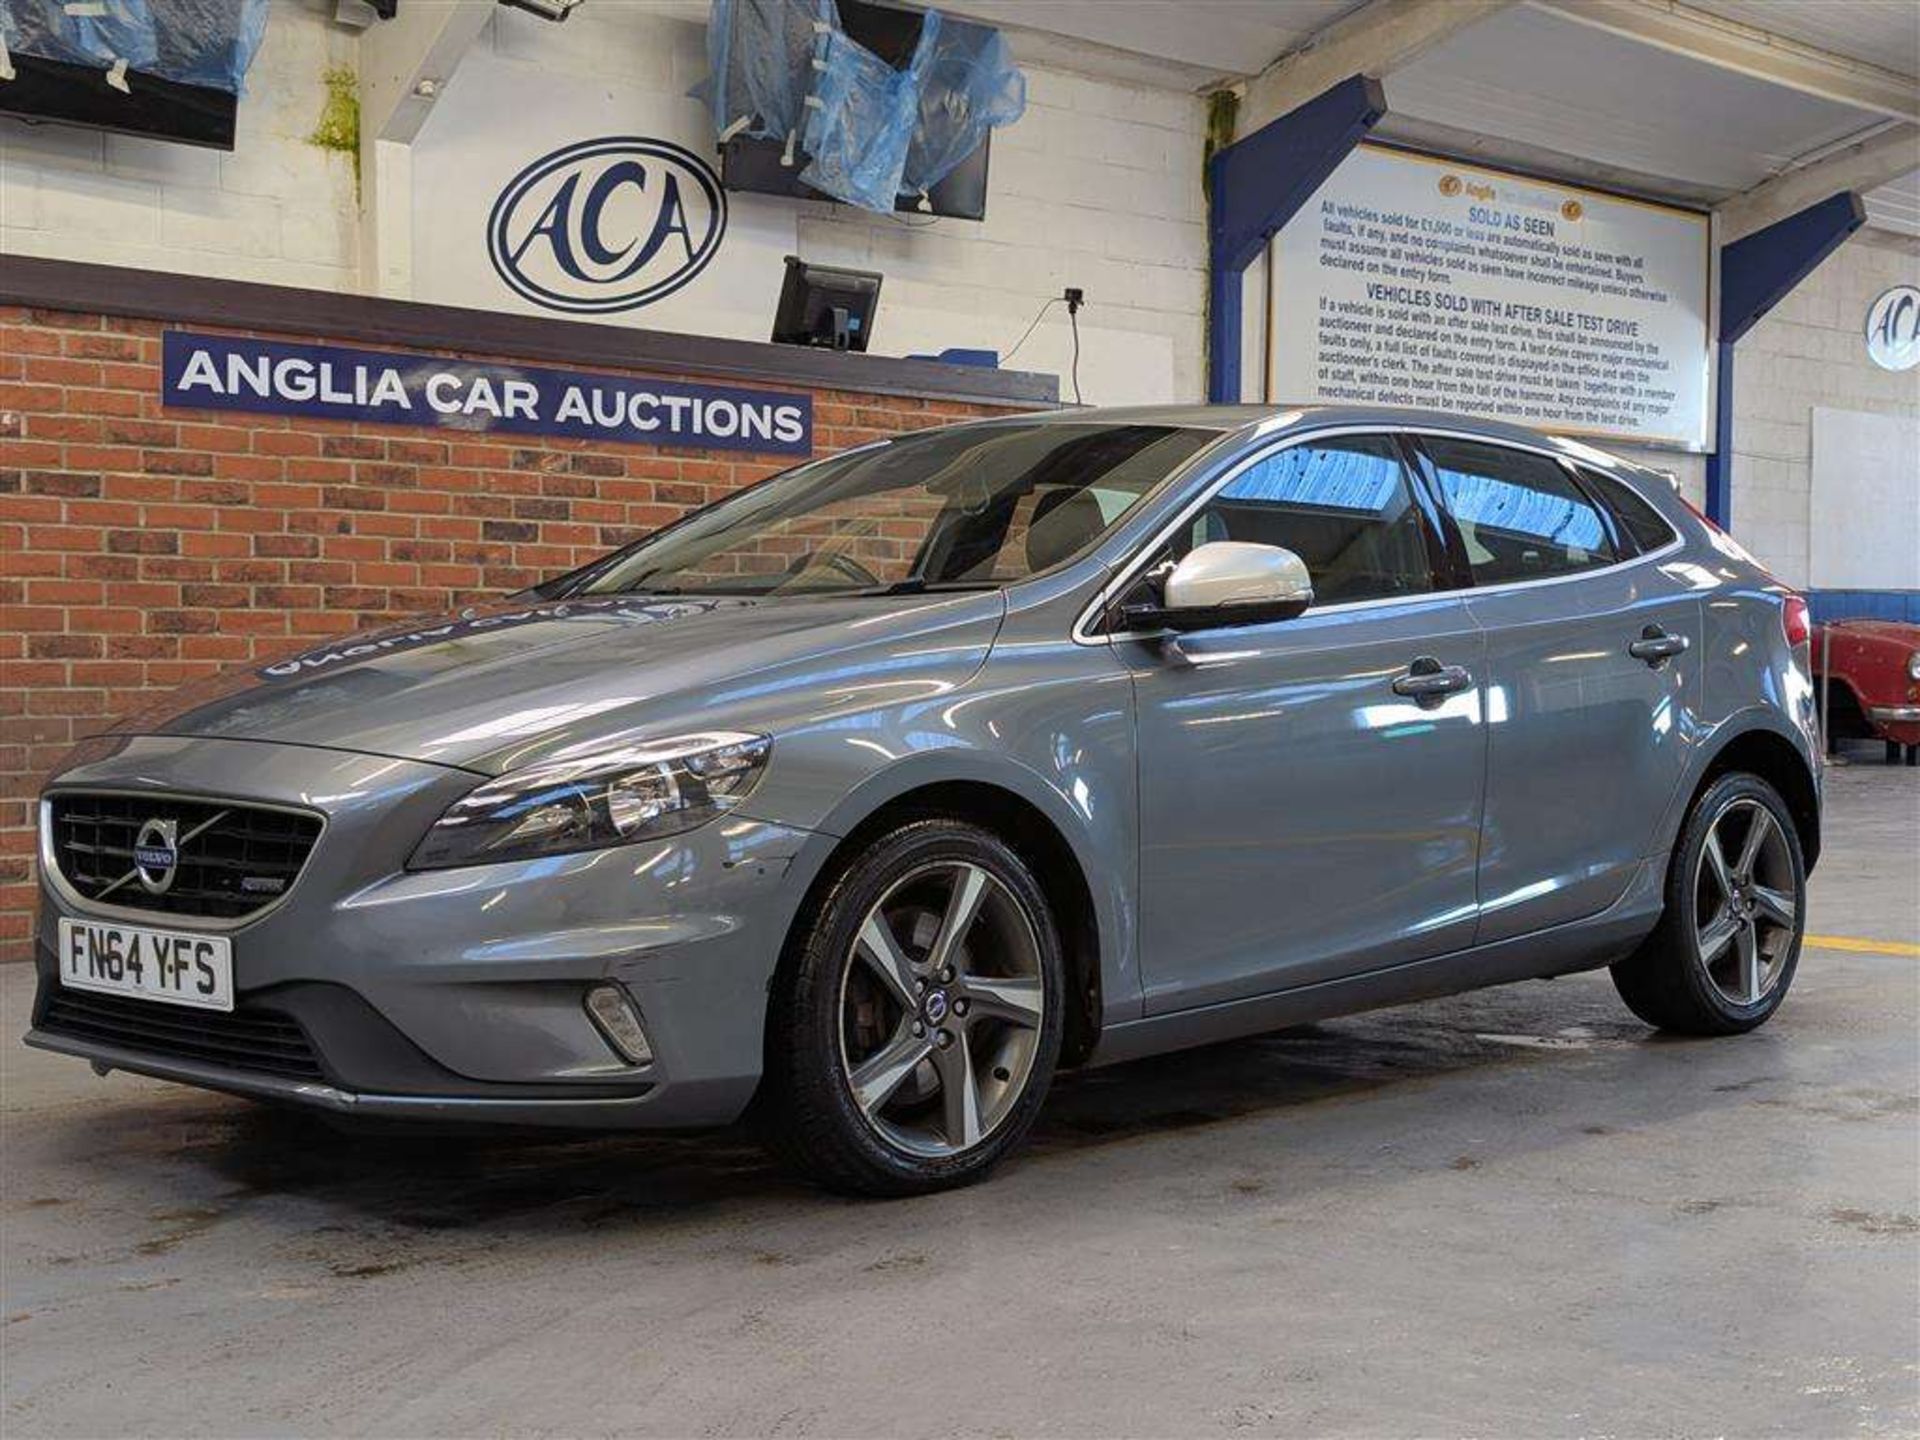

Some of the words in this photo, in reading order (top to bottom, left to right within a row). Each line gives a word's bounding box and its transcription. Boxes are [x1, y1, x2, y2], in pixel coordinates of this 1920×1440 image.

[511, 161, 694, 283] ACA
[1321, 200, 1335, 214] All
[1337, 205, 1379, 223] vehicles
[1381, 213, 1403, 225] sold
[1405, 216, 1419, 228] for
[1454, 227, 1463, 236] or
[1466, 228, 1484, 241] less
[1487, 232, 1500, 244] are
[1503, 235, 1560, 255] automatically
[1562, 244, 1581, 256] sold
[1582, 249, 1592, 259] as
[1595, 251, 1613, 264] seen
[1615, 255, 1632, 266] with
[1634, 257, 1643, 268] all
[1469, 207, 1502, 226] SOLD
[1505, 215, 1521, 231] AS
[1524, 218, 1555, 237] SEEN
[1320, 253, 1365, 271] declared
[1367, 262, 1379, 273] on
[1382, 263, 1398, 276] the
[1400, 267, 1425, 283] entry
[1320, 237, 1346, 250] must
[1348, 242, 1387, 257] assume
[1390, 246, 1402, 259] all
[1404, 250, 1443, 267] vehicles
[1446, 257, 1465, 270] sold
[1468, 262, 1478, 272] as
[1481, 262, 1501, 276] seen
[1504, 265, 1525, 280] have
[1526, 269, 1566, 286] incorrect
[1567, 278, 1599, 294] mileage
[1601, 284, 1628, 297] unless
[1629, 287, 1668, 303] otherwise
[1390, 232, 1408, 244] and
[1411, 235, 1423, 245] no
[1425, 238, 1475, 256] complaints
[1478, 245, 1528, 264] whatsoever
[1530, 253, 1548, 268] shall
[1551, 258, 1563, 270] be
[1320, 296, 1326, 310] If
[1329, 301, 1335, 311] a
[1337, 301, 1374, 317] vehicle
[1376, 307, 1385, 318] is
[1388, 308, 1409, 321] sold
[1411, 311, 1432, 324] with
[1434, 315, 1446, 325] an
[1448, 316, 1468, 329] after
[1471, 320, 1489, 333] sale
[1491, 323, 1508, 335] test
[1537, 328, 1553, 340] this
[1555, 332, 1575, 343] shall
[1577, 334, 1587, 345] be
[1589, 336, 1633, 351] announced
[1635, 343, 1645, 355] by
[1646, 343, 1659, 354] the
[1366, 282, 1431, 307] VEHICLES
[1435, 292, 1468, 312] SOLD
[1471, 298, 1501, 317] WITH
[1505, 303, 1542, 323] AFTER
[1544, 309, 1574, 328] SALE
[1577, 314, 1604, 331] TEST
[1607, 318, 1640, 337] DRIVE
[1319, 332, 1347, 347] faults
[1375, 341, 1382, 351] a
[1384, 341, 1399, 352] full
[1402, 342, 1417, 354] list
[1419, 344, 1430, 355] of
[1432, 346, 1457, 360] faults
[1460, 351, 1496, 366] covered
[1498, 354, 1505, 366] is
[1507, 356, 1550, 373] displayed
[1552, 361, 1560, 372] in
[1562, 362, 1575, 374] the
[1577, 365, 1600, 377] office
[1603, 368, 1617, 379] and
[1619, 370, 1635, 380] with
[1637, 372, 1650, 383] the
[1320, 316, 1372, 333] auctioneer
[1375, 325, 1393, 336] and
[1395, 326, 1438, 341] declared
[1439, 332, 1451, 343] on
[1453, 333, 1468, 345] the
[1470, 336, 1493, 350] entry
[1520, 341, 1527, 352] A
[1528, 343, 1546, 355] test
[1547, 345, 1568, 357] drive
[1571, 349, 1598, 362] covers
[1601, 352, 1623, 367] major
[1625, 356, 1669, 370] mechanical
[177, 351, 411, 409] ANGLIA
[426, 373, 539, 420] CAR
[555, 386, 803, 443] AUCTIONS
[1318, 350, 1379, 368] auctioneer's
[1411, 359, 1429, 373] The
[1431, 363, 1453, 375] after
[1455, 366, 1474, 378] sale
[1475, 369, 1493, 380] test
[1495, 371, 1517, 382] drive
[1519, 373, 1542, 385] must
[1543, 376, 1554, 387] be
[1584, 380, 1618, 394] together
[1619, 384, 1636, 396] with
[1644, 388, 1676, 401] member
[1318, 367, 1329, 379] of
[1360, 372, 1390, 385] within
[1391, 376, 1410, 388] one
[1411, 377, 1435, 390] hour
[1436, 380, 1458, 393] from
[1460, 381, 1475, 394] the
[1492, 386, 1503, 397] of
[1503, 387, 1517, 398] the
[1558, 392, 1574, 407] Any
[1576, 396, 1621, 411] complaints
[1622, 400, 1630, 409] of
[1632, 402, 1645, 415] any
[1647, 403, 1670, 416] major
[1318, 384, 1375, 400] mechanical
[1378, 389, 1414, 404] defects
[1416, 396, 1439, 409] must
[1442, 395, 1454, 408] be
[1455, 399, 1495, 412] reported
[1496, 403, 1523, 415] within
[1524, 406, 1541, 417] one
[1543, 406, 1562, 419] hour
[1564, 407, 1585, 420] from
[1586, 410, 1598, 421] the
[1600, 412, 1617, 424] test
[137, 851, 172, 864] VOLVO
[71, 926, 143, 984] FN64
